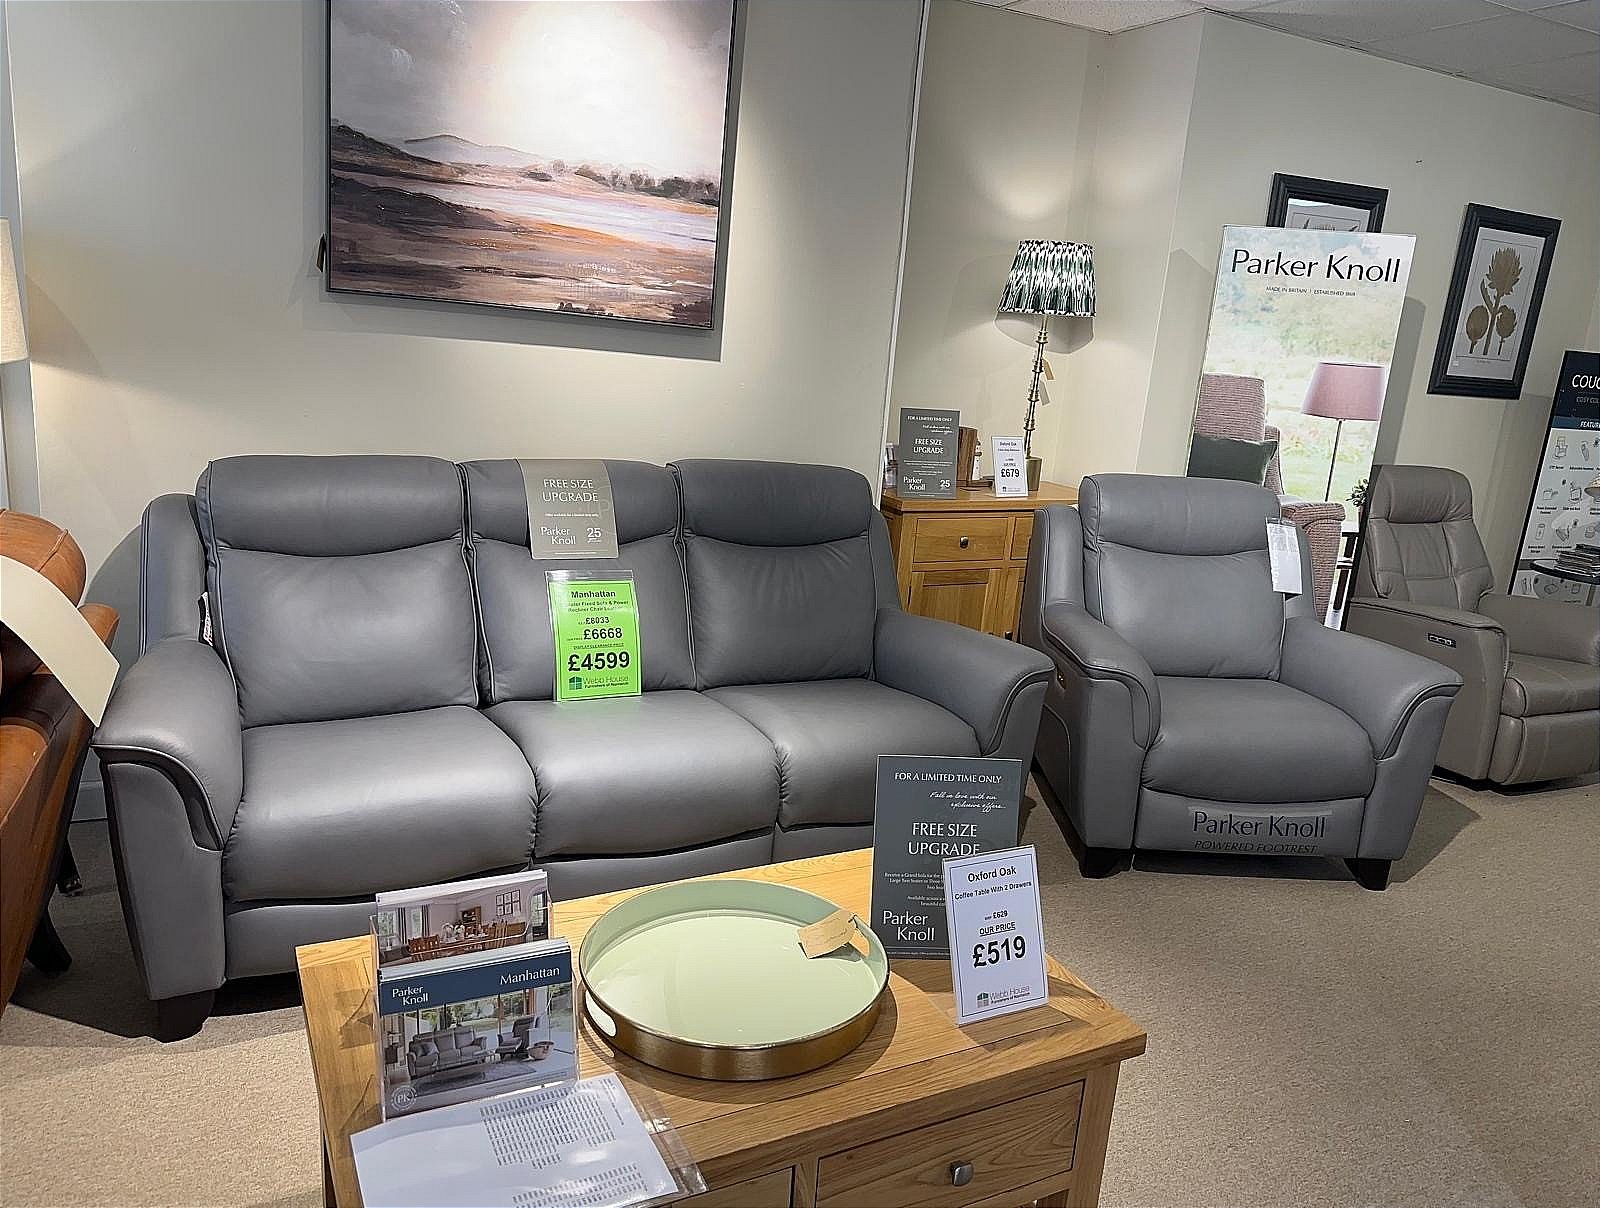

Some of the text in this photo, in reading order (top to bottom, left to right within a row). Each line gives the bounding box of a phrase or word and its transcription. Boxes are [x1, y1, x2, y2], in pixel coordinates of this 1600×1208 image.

[1231, 249, 1401, 283] Parker Knoll
[913, 446, 944, 454] UPGRADE
[1001, 468, 1020, 478] £679
[543, 479, 594, 489] FREE SIZE
[909, 483, 926, 491] Knoll
[940, 479, 951, 488] 25
[542, 491, 598, 502] UPGRADE
[540, 525, 602, 538] Parker 25
[551, 535, 576, 545] Knoll
[571, 590, 616, 598] Manhattan
[583, 627, 623, 640] £6668
[568, 651, 630, 672] £4599
[895, 772, 1002, 784] FOR A LIMITED TIME ONLY
[954, 791, 968, 799] love
[969, 792, 985, 800] with
[912, 822, 978, 837] FREE SIZE
[1193, 811, 1326, 838] Parker Knoll
[908, 842, 981, 857] UPGRADE
[1194, 840, 1319, 854] POWERED FOOTREST
[967, 865, 1017, 883] Oxford Oak
[954, 892, 974, 900] Coffee
[974, 888, 990, 896] Table
[990, 885, 1004, 894] With
[1009, 881, 1032, 890] Drawers
[883, 910, 929, 926] Parker
[992, 909, 1008, 919] £629
[897, 926, 935, 941] Knoll
[979, 921, 1016, 936] OUR PRICE
[972, 935, 1026, 969] £519
[500, 966, 561, 985] Manhattan
[392, 985, 424, 998] Parker
[1009, 985, 1030, 995] House
[402, 992, 429, 1006] Knoll
